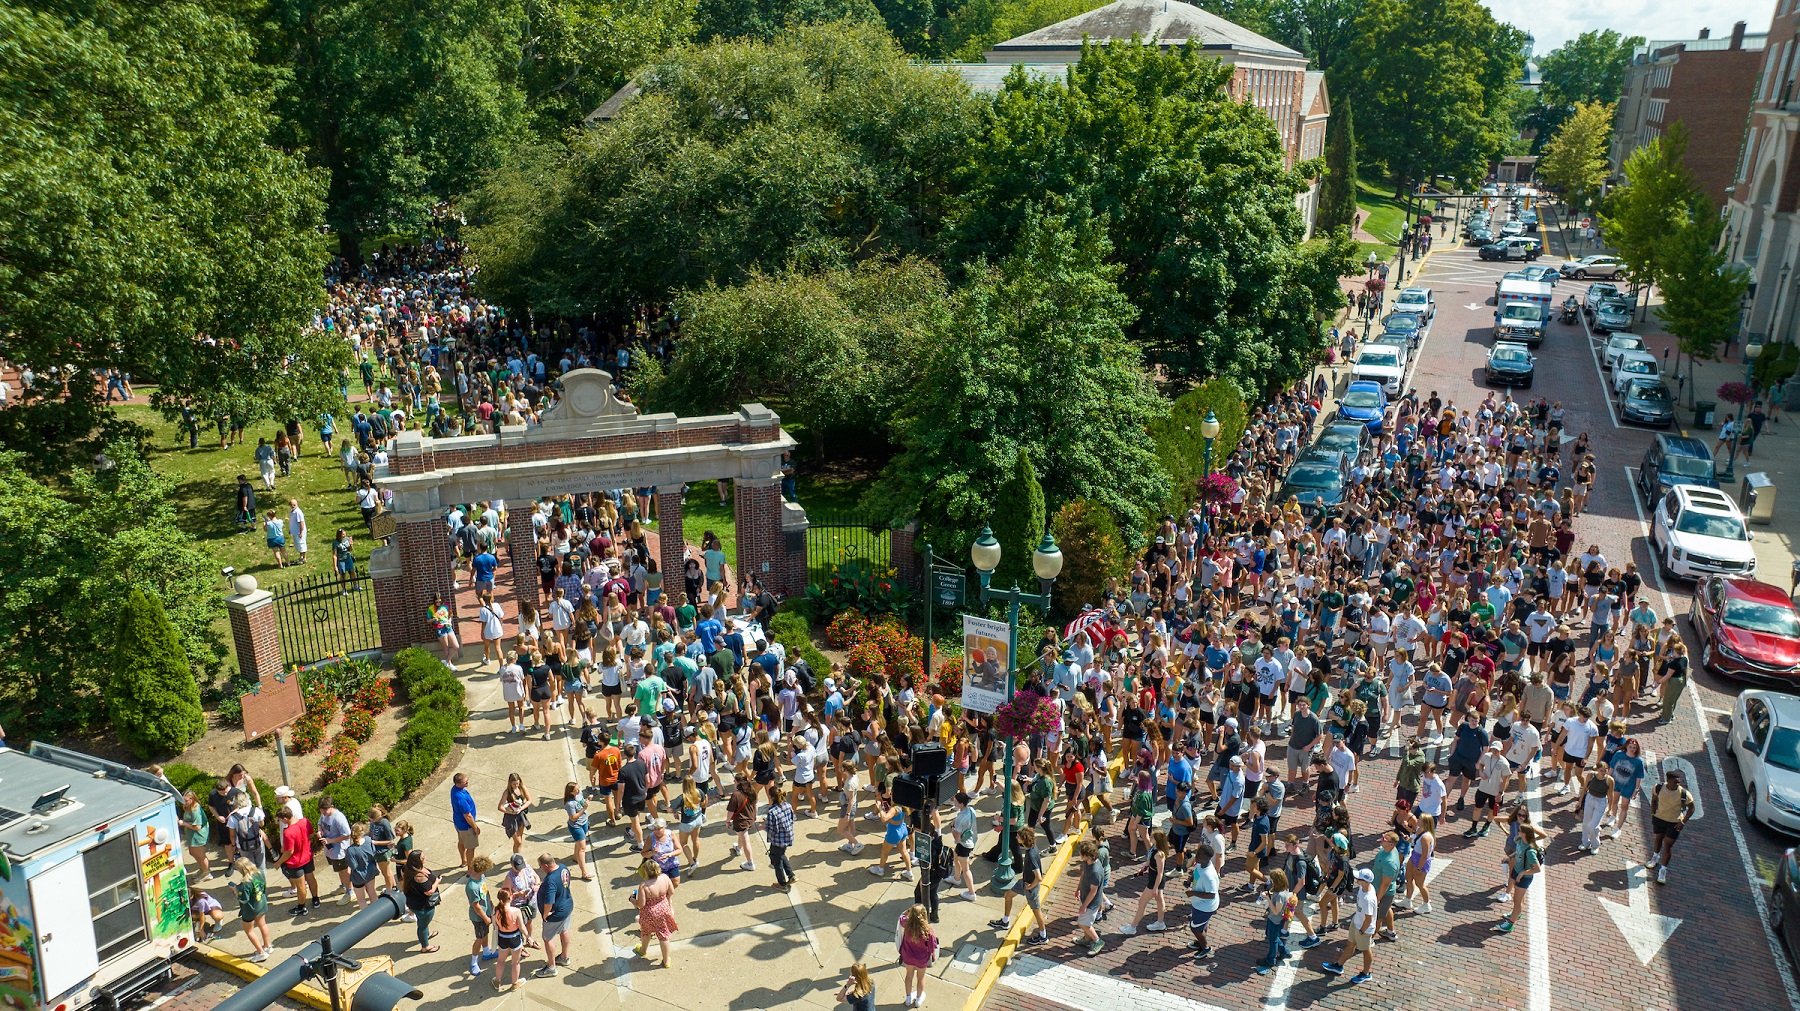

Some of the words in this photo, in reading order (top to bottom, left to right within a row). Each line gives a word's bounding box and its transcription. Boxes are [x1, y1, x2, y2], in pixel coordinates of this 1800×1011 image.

[545, 483, 582, 491] KNOWLEDGE
[586, 480, 611, 488] WISDOM
[938, 575, 959, 583] College
[940, 581, 957, 589] Green
[967, 619, 987, 628] Foster
[987, 623, 1006, 633] bright
[975, 628, 999, 639] futures.
